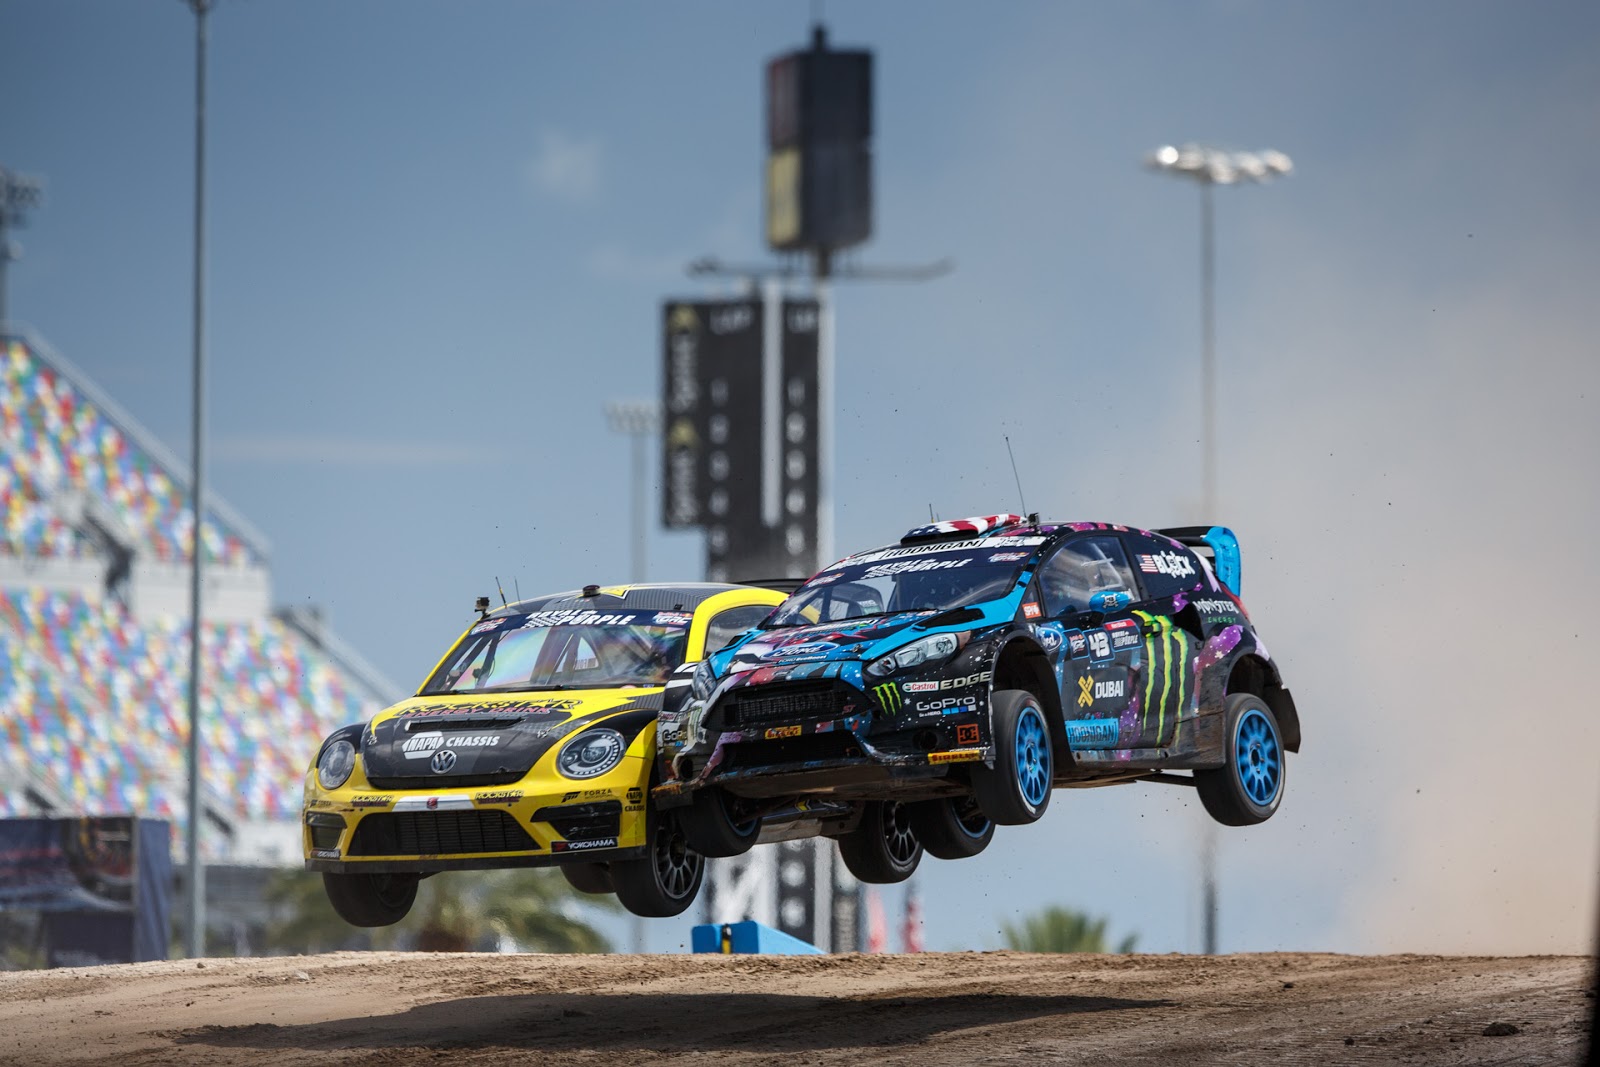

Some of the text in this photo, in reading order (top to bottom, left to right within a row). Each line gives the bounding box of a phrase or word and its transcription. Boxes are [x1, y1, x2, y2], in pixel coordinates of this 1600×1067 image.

[1193, 598, 1239, 614] MONSTER
[554, 614, 637, 627] PURPLE
[772, 645, 825, 657] Ford
[1088, 632, 1110, 658] 43
[911, 671, 992, 691] Castrol EDGE
[1095, 680, 1124, 699] DUBAI
[916, 696, 976, 712] GoPro
[403, 706, 550, 718] ENERGY DRINK
[407, 736, 500, 751] NAPA CHASSIS
[584, 788, 612, 796] FORZA
[568, 838, 615, 850] YOKOHAMA
